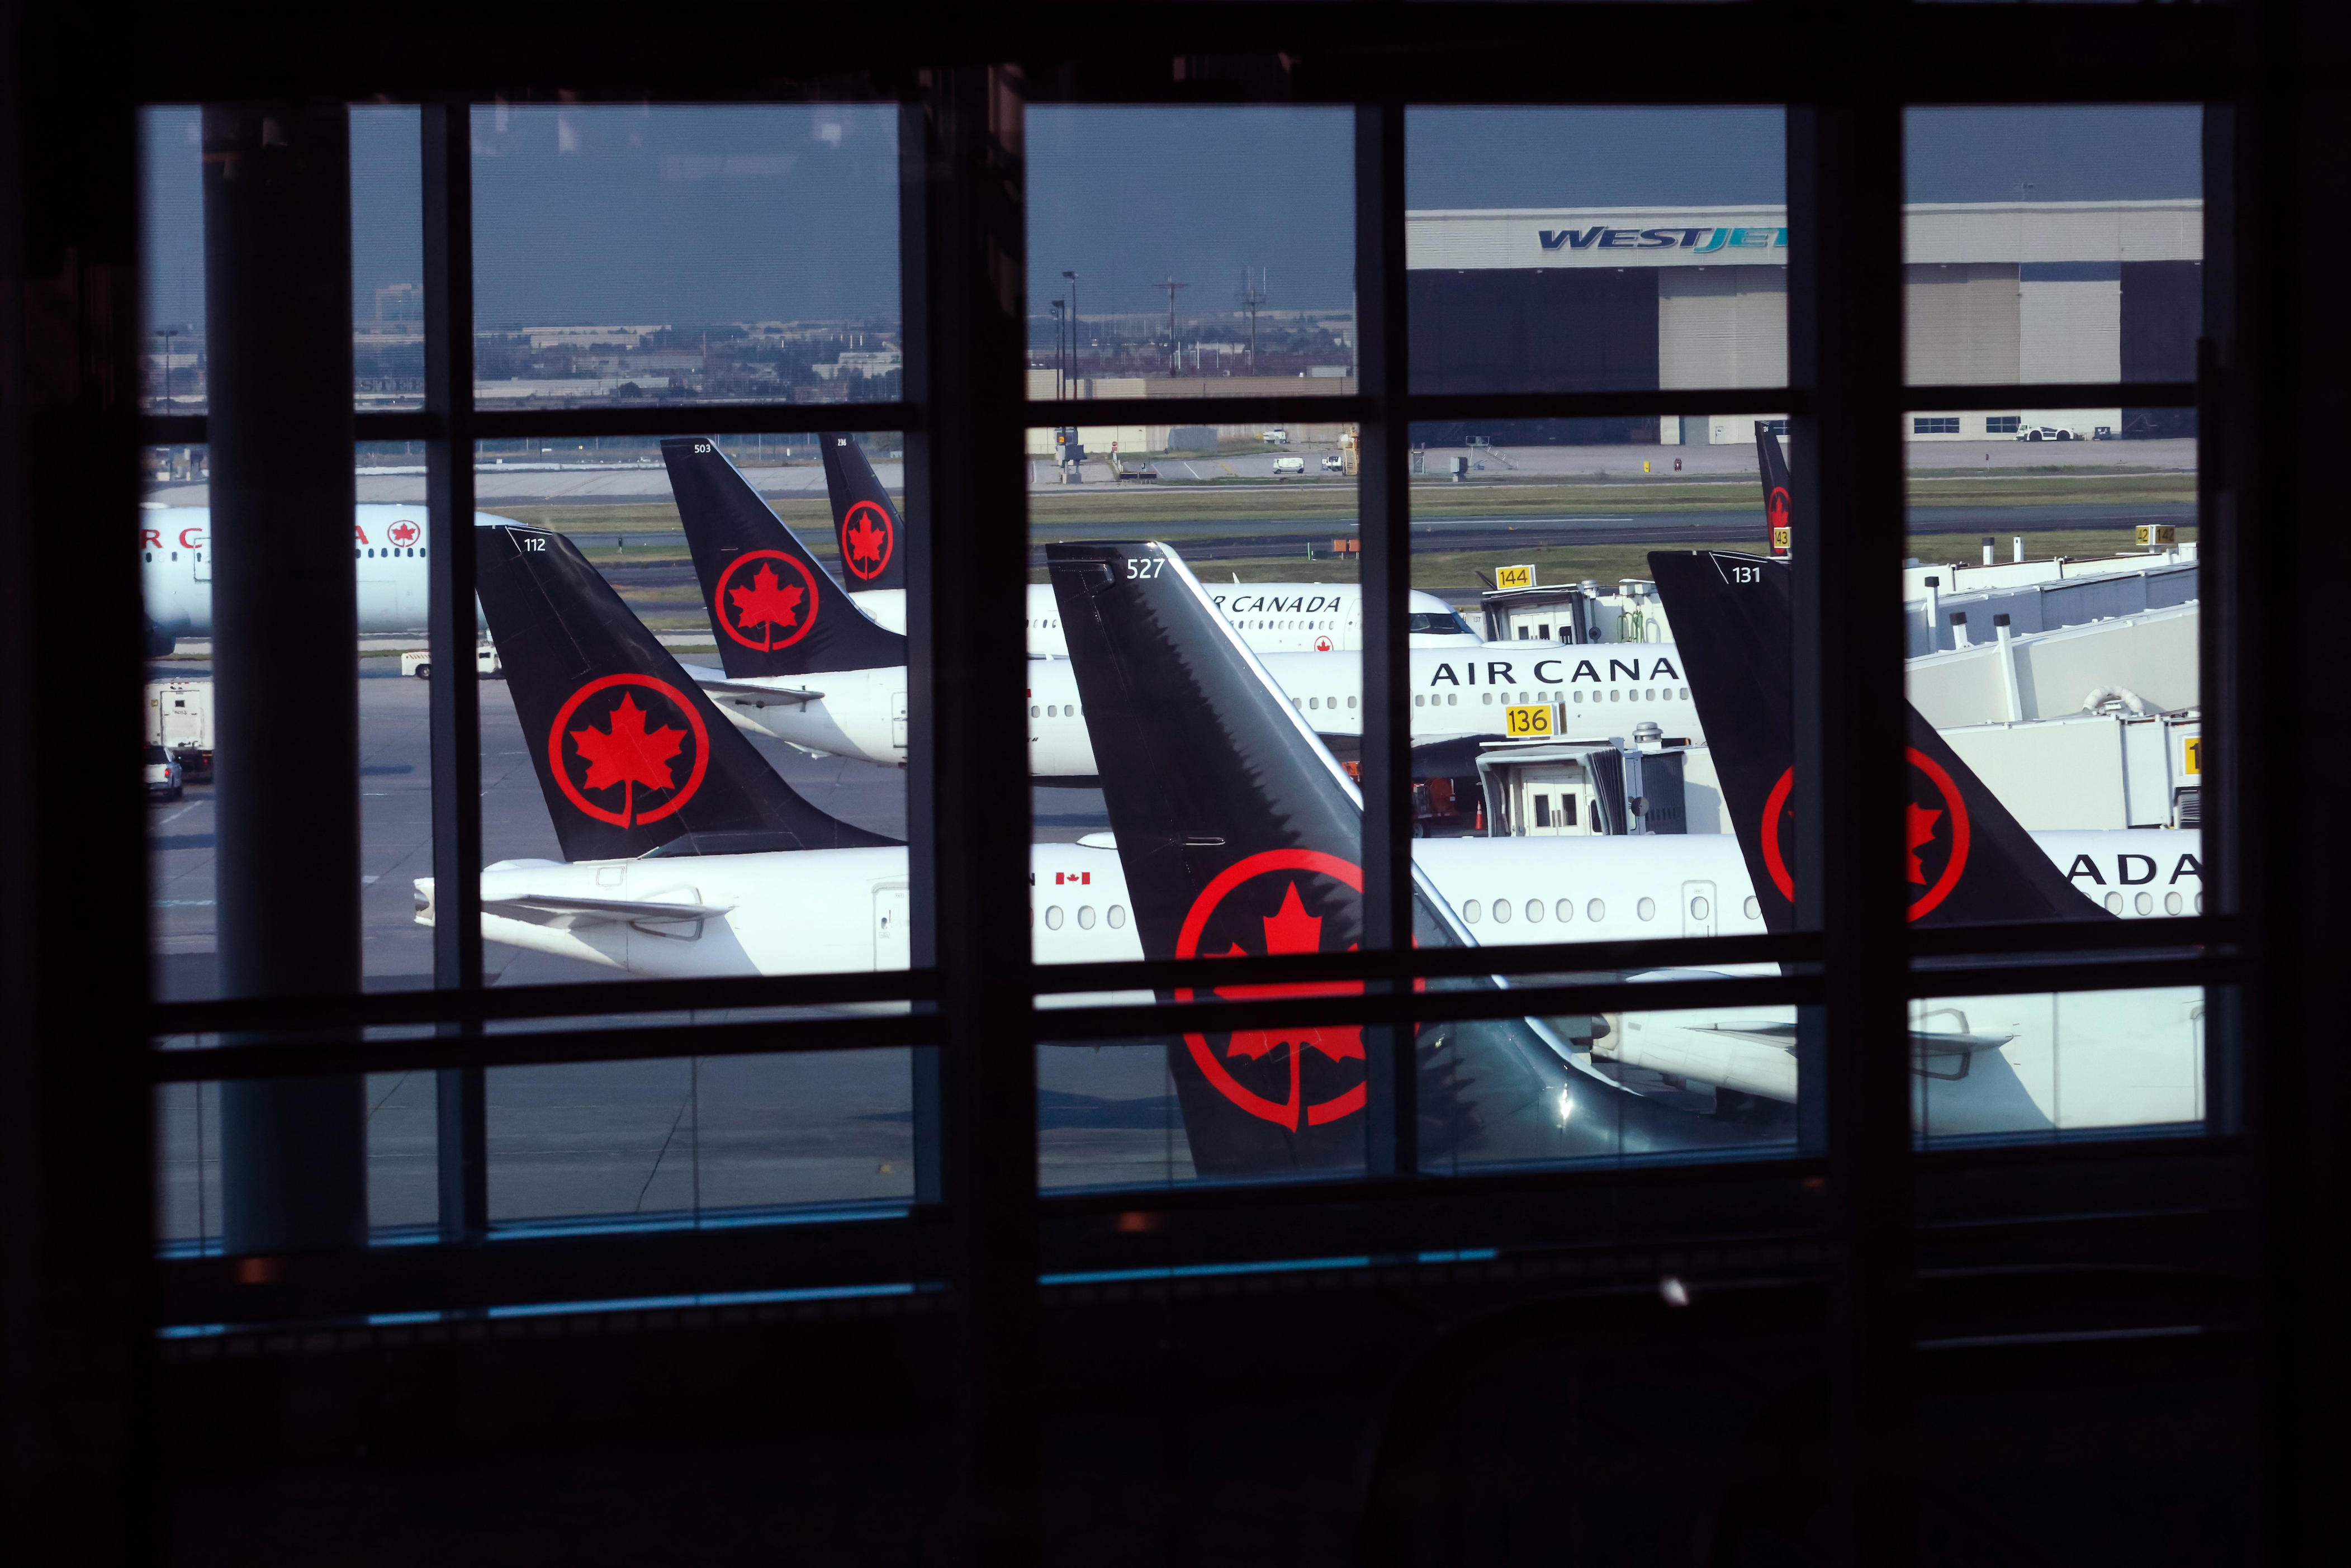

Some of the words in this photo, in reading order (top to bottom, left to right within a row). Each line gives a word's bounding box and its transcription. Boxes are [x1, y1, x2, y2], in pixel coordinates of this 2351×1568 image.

[694, 444, 711, 453] 503
[524, 538, 546, 552] 112
[1775, 532, 1788, 544] 143
[1127, 558, 1165, 579] 527
[1732, 567, 1760, 582] 131
[1500, 570, 1528, 585] 144
[1232, 596, 1341, 612] CANADA
[1430, 662, 1517, 686] AIR
[1534, 657, 1680, 684] CANA
[1509, 709, 1547, 732] 136
[2066, 854, 2203, 885] ADA
